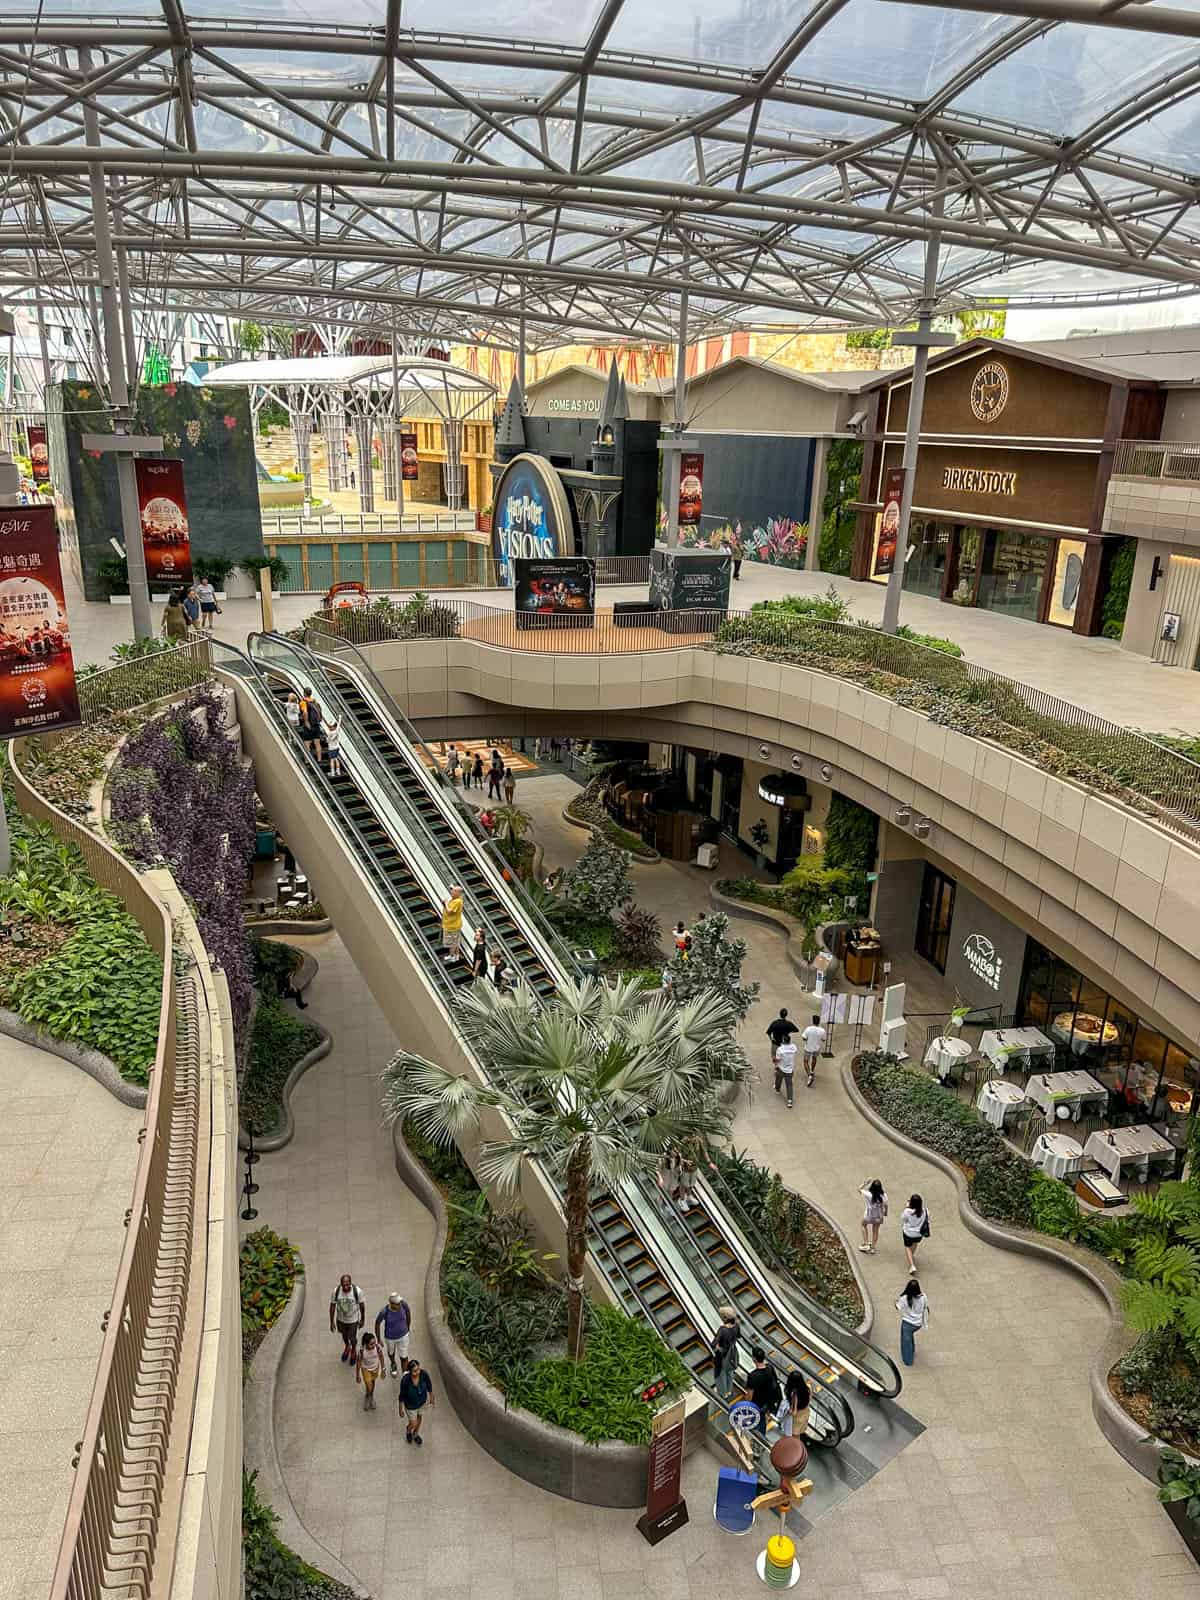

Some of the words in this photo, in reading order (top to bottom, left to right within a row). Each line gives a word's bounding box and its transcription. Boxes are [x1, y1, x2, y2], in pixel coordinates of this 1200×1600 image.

[549, 399, 570, 411] COME
[571, 400, 583, 411] AS
[584, 400, 600, 412] YOU
[942, 466, 1017, 496] BIRKENSTOCK
[0, 519, 32, 535] EAVE
[498, 526, 554, 559] VISIONS
[0, 553, 42, 569] 魅奇遇
[963, 945, 995, 977] JUMBO
